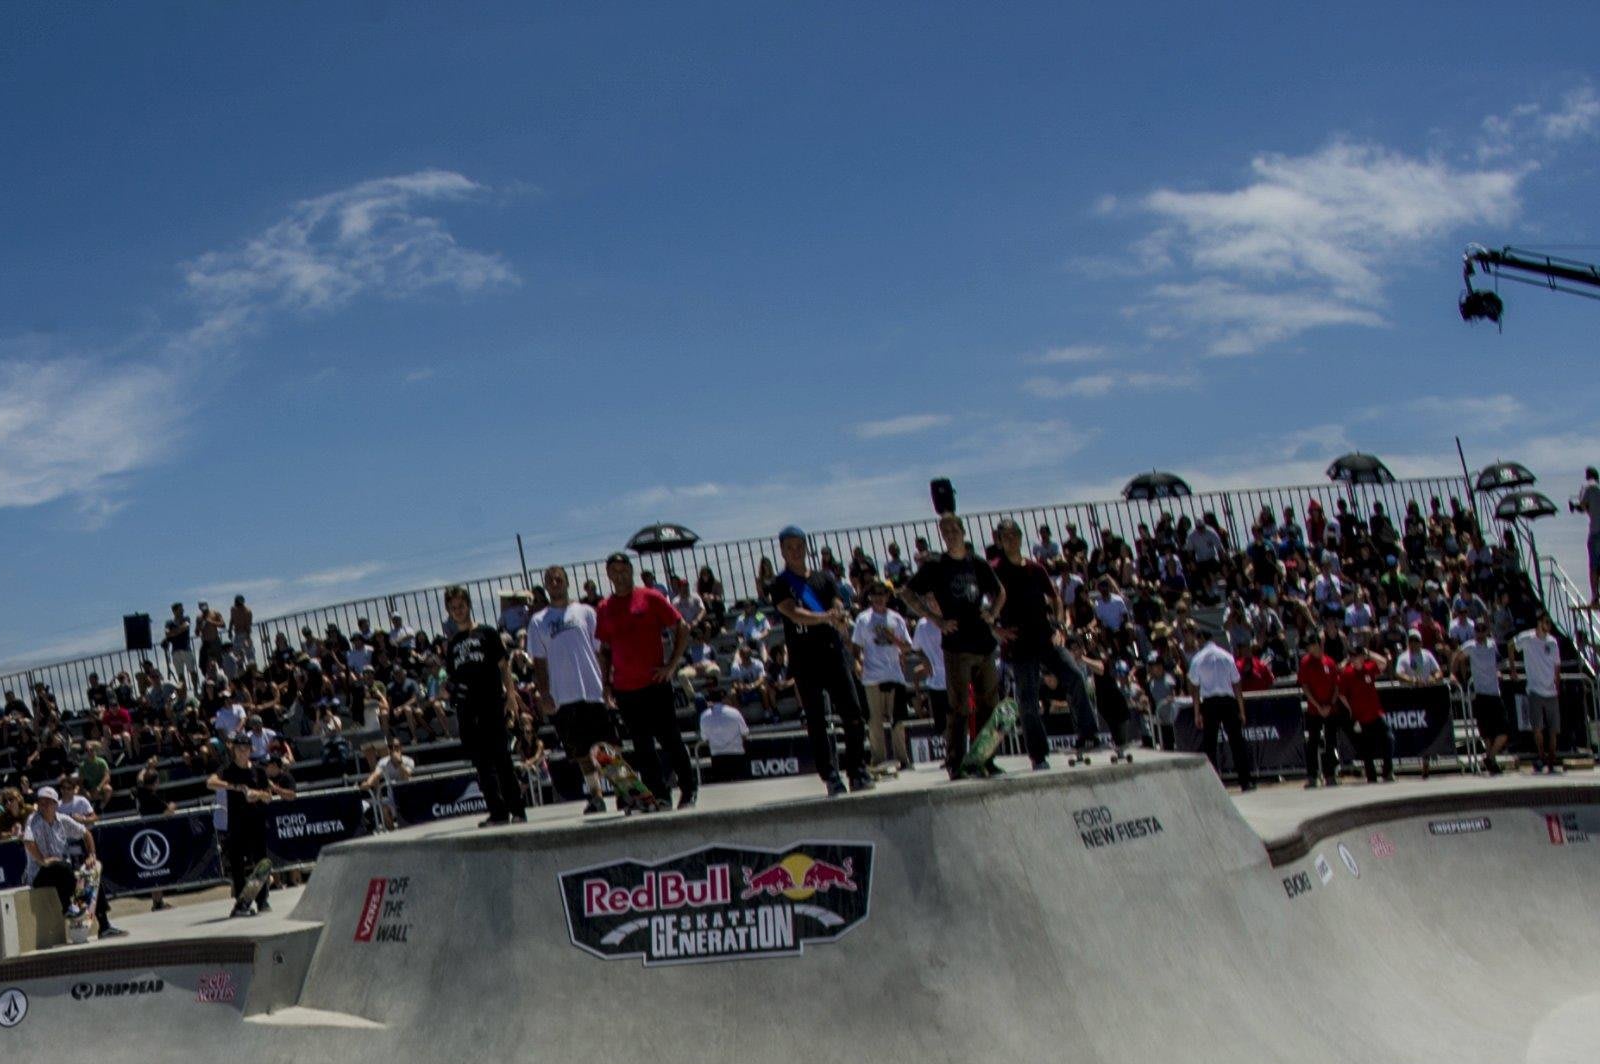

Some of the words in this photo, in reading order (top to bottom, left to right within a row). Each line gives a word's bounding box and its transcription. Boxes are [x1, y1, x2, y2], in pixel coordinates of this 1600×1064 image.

[432, 799, 487, 818] CERANIUM
[1073, 805, 1112, 830] FORD
[275, 814, 307, 827] FORD
[277, 826, 305, 840] NEW
[306, 819, 345, 834] FIESTA
[1080, 826, 1116, 850] NEW
[1116, 815, 1164, 845] FIESTA
[680, 909, 756, 931] SKATE
[651, 904, 795, 958] GENERATION
[94, 979, 164, 997] DROPDEAD
